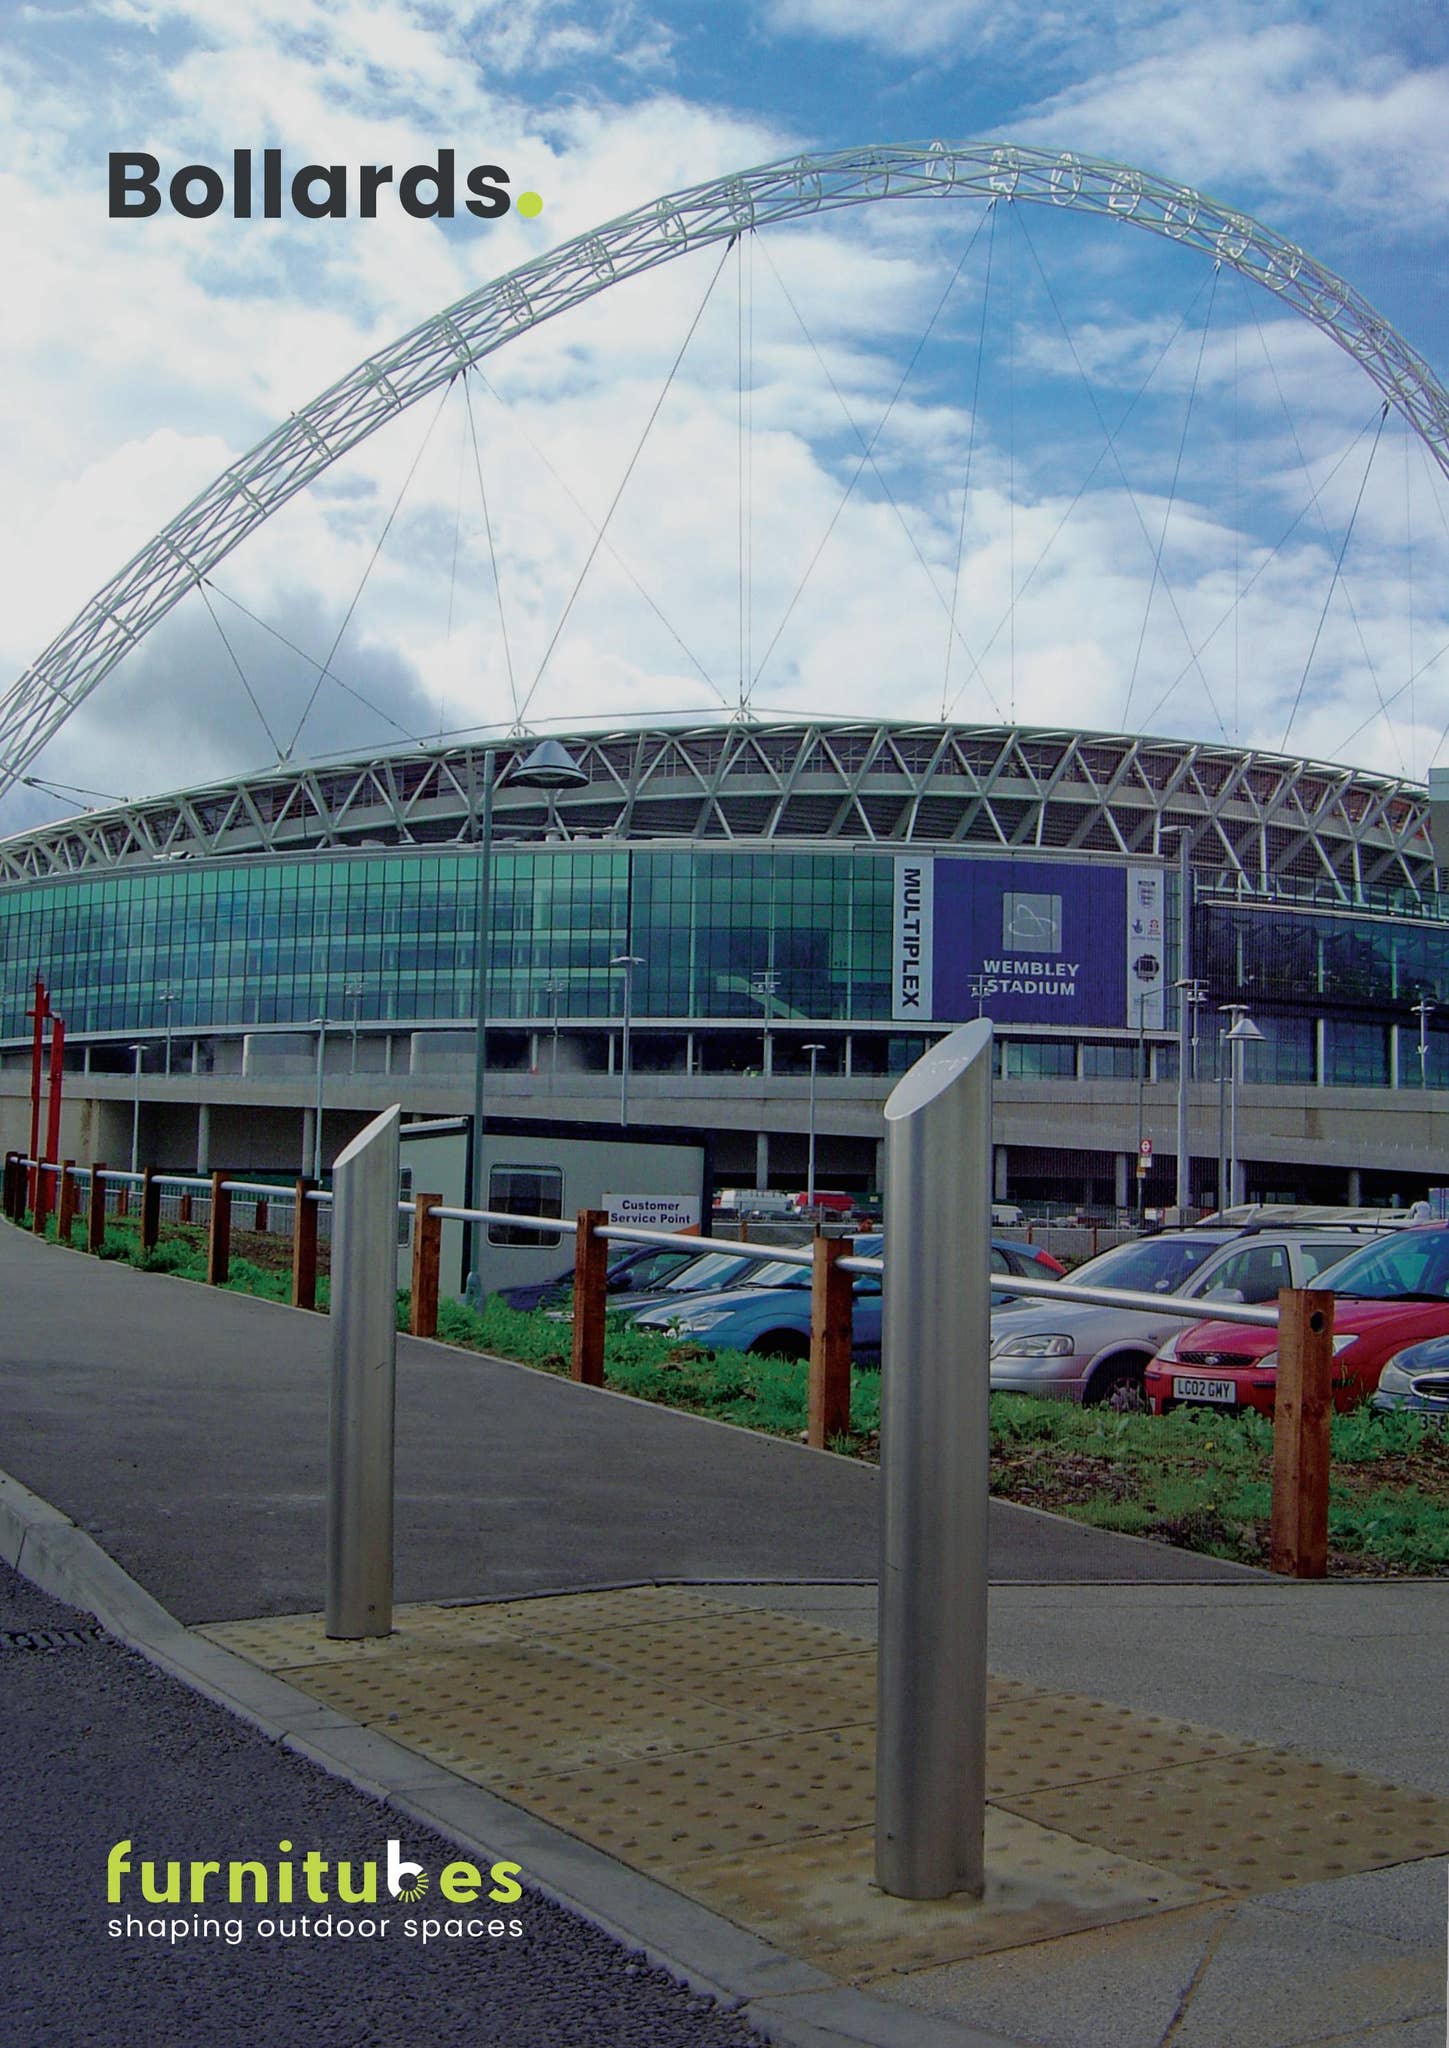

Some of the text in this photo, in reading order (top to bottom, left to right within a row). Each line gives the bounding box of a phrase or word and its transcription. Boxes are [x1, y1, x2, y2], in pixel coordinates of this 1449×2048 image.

[902, 868, 921, 1008] MULTIPLEX
[983, 959, 1080, 977] WEMBLEY
[987, 979, 1075, 996] STADIUM
[622, 1200, 680, 1211] Customer
[611, 1213, 691, 1224] Service Point
